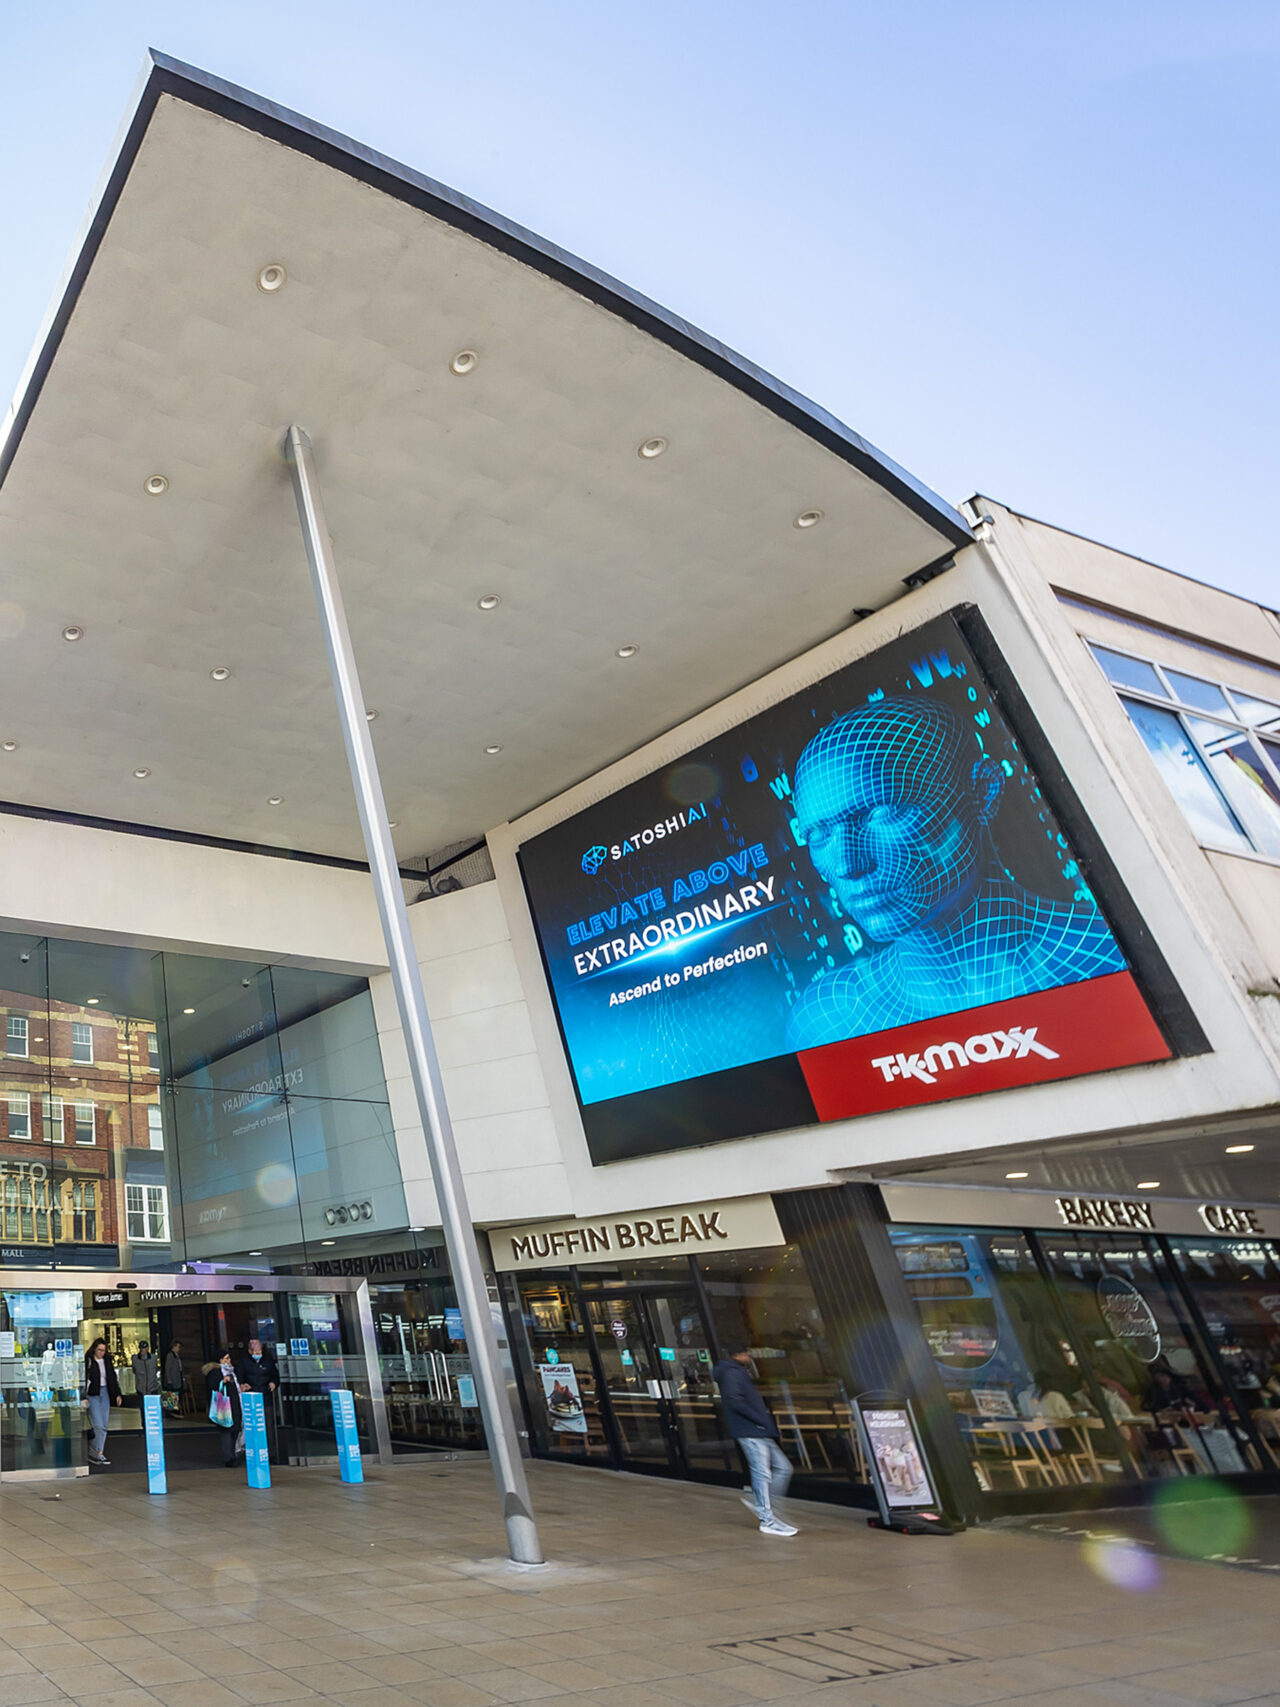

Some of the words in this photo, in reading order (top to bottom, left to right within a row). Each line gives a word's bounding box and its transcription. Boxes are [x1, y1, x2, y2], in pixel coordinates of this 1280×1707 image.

[566, 887, 667, 946] ELEVATE
[672, 842, 769, 903] ABOVE
[573, 875, 776, 976] EXTRAORDINARY
[608, 976, 662, 1008] Ascend
[664, 973, 681, 988] to
[683, 941, 768, 982] Perfection
[13, 1160, 48, 1182] TO
[510, 1226, 611, 1261] MUFFIN
[614, 1211, 728, 1249] BREAK
[1055, 1197, 1156, 1230] BAKERY
[1, 1248, 25, 1258] MALL
